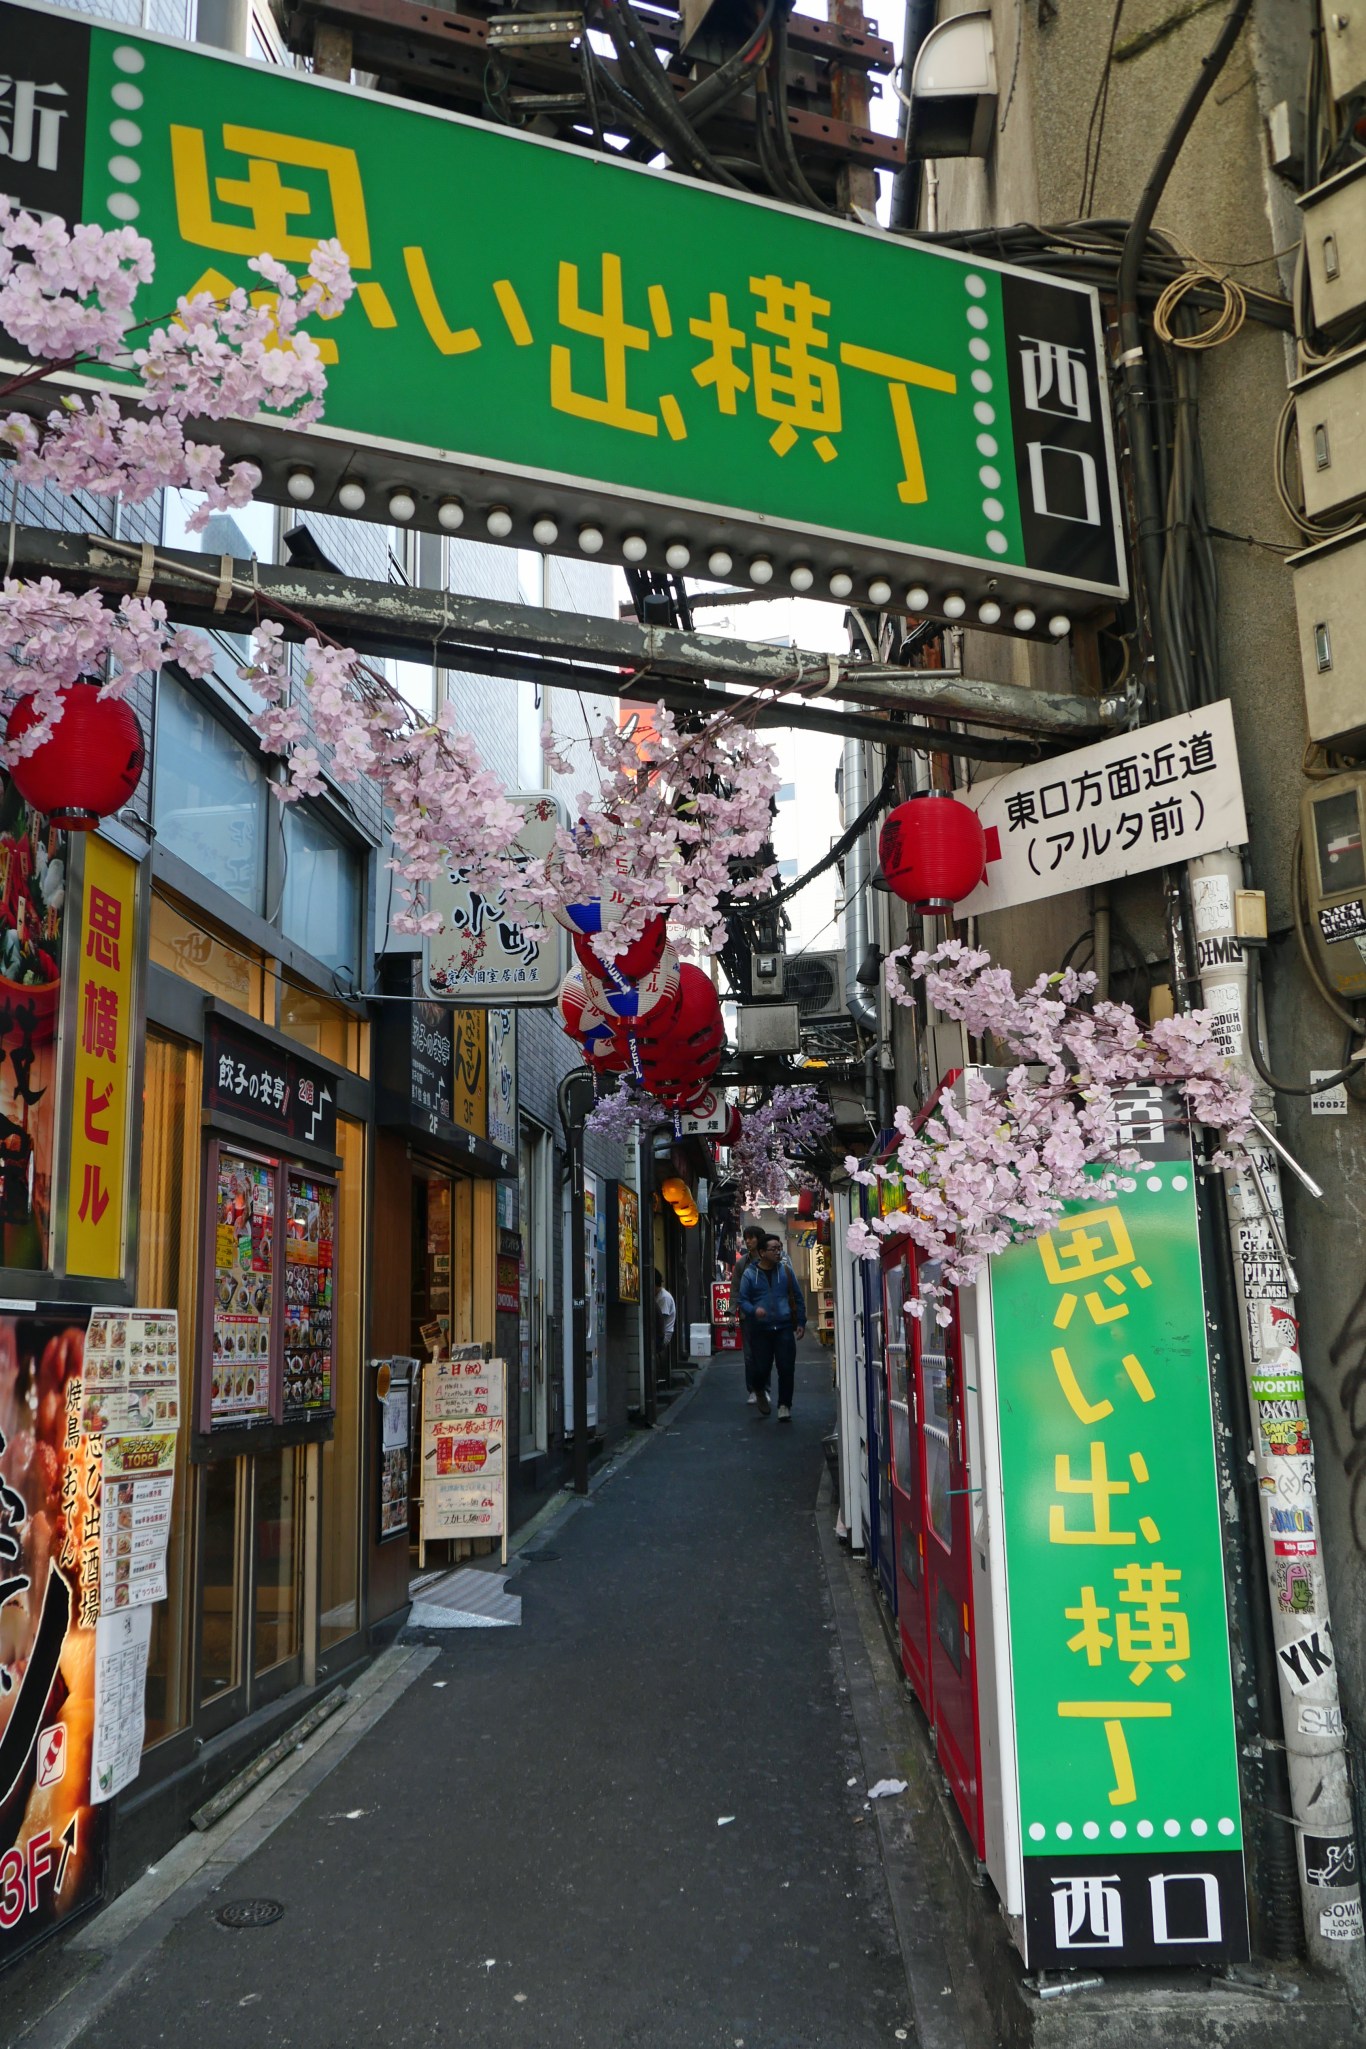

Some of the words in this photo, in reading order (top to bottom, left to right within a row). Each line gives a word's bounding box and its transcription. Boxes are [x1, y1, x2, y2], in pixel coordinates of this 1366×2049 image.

[170, 122, 957, 504] 思い出横丁
[1017, 333, 1101, 527] 西口
[1004, 730, 1217, 833] 東口方面近道
[447, 968, 540, 985] 完全個室居酒屋
[77, 884, 121, 1226] 思横ビル
[218, 1053, 285, 1109] 餃子の安亭
[429, 1113, 439, 1135] 2F
[468, 1134, 476, 1153] 3F
[687, 1121, 719, 1131] 禁煙
[60, 1379, 82, 1565] 焼鳥・おでん
[127, 1453, 155, 1467] TOP5
[1037, 1206, 1191, 1806] 思い出横丁
[0, 1829, 51, 1927] 3F
[1050, 1873, 1222, 1949] 西口
[1324, 1928, 1349, 1938] TRAP
[1332, 1918, 1359, 1928] LOCAL
